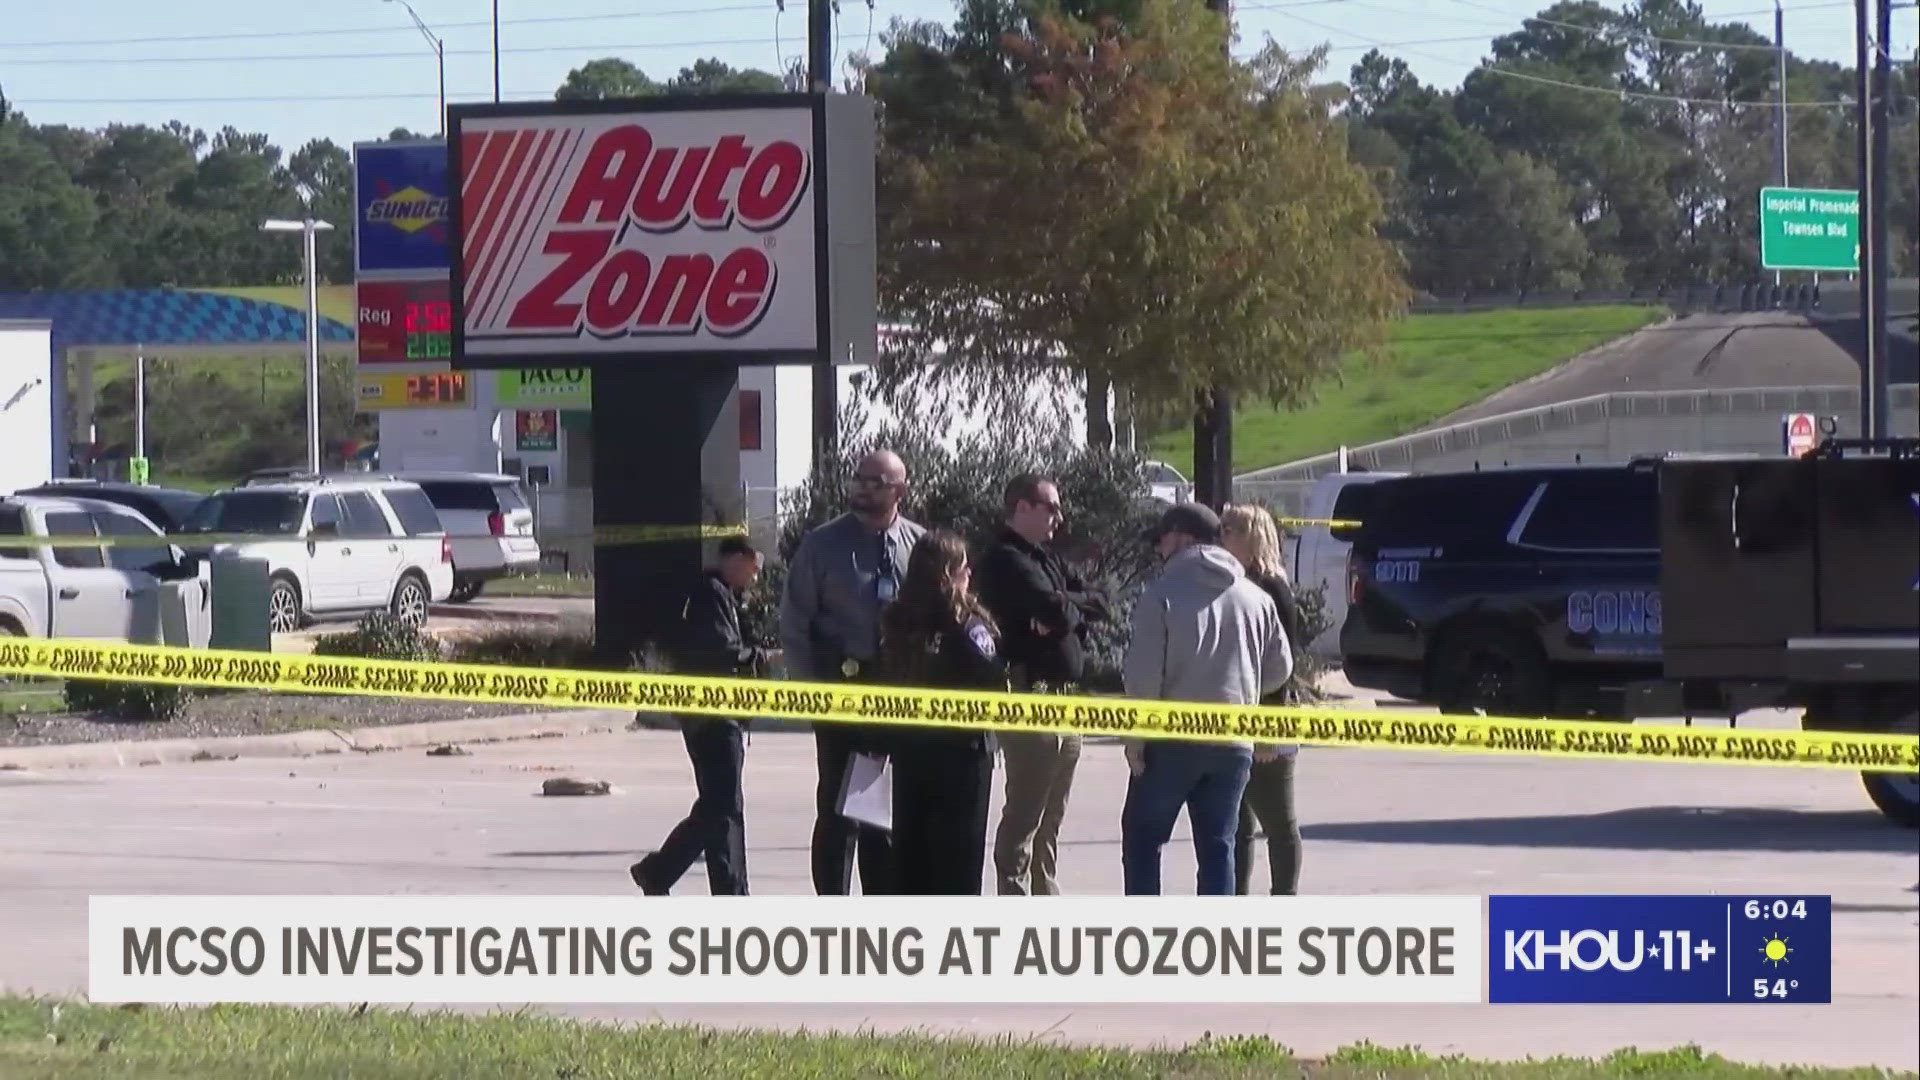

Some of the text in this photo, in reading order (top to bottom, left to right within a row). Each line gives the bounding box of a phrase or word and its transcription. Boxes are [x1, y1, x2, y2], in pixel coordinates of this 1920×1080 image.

[556, 124, 808, 232] Auto
[1766, 197, 1806, 214] Imperial
[1783, 220, 1847, 237] Townsen Blvd
[502, 229, 777, 338] Zone
[360, 307, 391, 326] Reg
[50, 649, 104, 672] CRIME
[106, 652, 160, 676] SCENE
[161, 655, 187, 678] DO
[188, 657, 223, 681] NOT
[224, 658, 282, 683] CROSS
[301, 663, 360, 688] CRIME
[361, 667, 418, 692] SCENE
[420, 670, 448, 694] DO
[449, 672, 487, 696] NOT
[488, 673, 549, 698] CROSS
[571, 679, 632, 703] CRIME
[634, 682, 696, 707] SCENE
[698, 685, 727, 709] DO
[729, 687, 768, 711] NOT
[770, 689, 833, 714] CROSS
[858, 694, 923, 719] CRIME
[926, 698, 991, 722] SCENE
[994, 701, 1025, 724] DO
[1026, 702, 1066, 726] NOT
[1070, 705, 1138, 730] CROSS
[1164, 711, 1230, 735] CRIME
[1233, 713, 1301, 738] SCENE
[1304, 717, 1337, 739] DO
[1339, 718, 1383, 741] NOT
[1387, 721, 1457, 745] CROSS
[1485, 726, 1556, 750] CRIME
[1560, 729, 1633, 753] SCENE
[1636, 733, 1670, 757] DO
[1672, 736, 1717, 759] NOT
[1722, 737, 1796, 760] CROSS
[1827, 741, 1903, 765] CRIME
